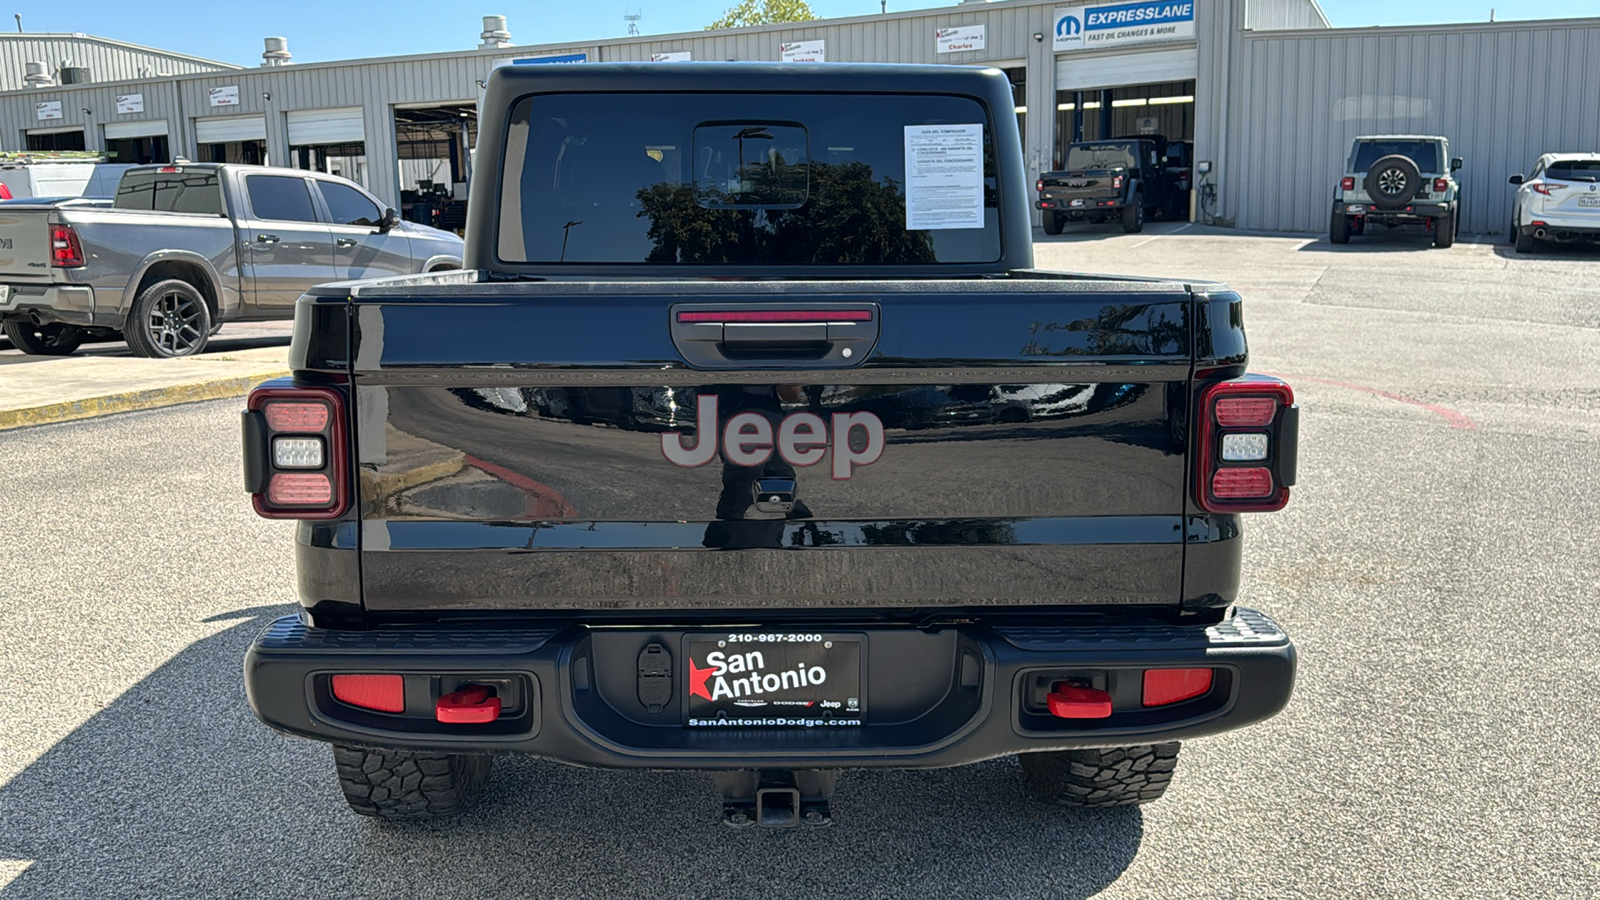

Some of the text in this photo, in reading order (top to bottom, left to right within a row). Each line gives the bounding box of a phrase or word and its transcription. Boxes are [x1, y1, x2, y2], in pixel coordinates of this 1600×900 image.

[1087, 3, 1192, 26] EXPRESSLANE
[1088, 33, 1104, 41] FAST
[1105, 32, 1116, 40] OIL
[1117, 29, 1149, 39] CHANGES
[1156, 26, 1176, 34] MORE
[661, 394, 885, 480] Jeep
[728, 633, 823, 642] 210-967-2000
[706, 651, 765, 676] San
[712, 662, 827, 701] Antonio
[820, 700, 841, 709] Jeep
[688, 718, 861, 727] SanAntonioDodge.com
